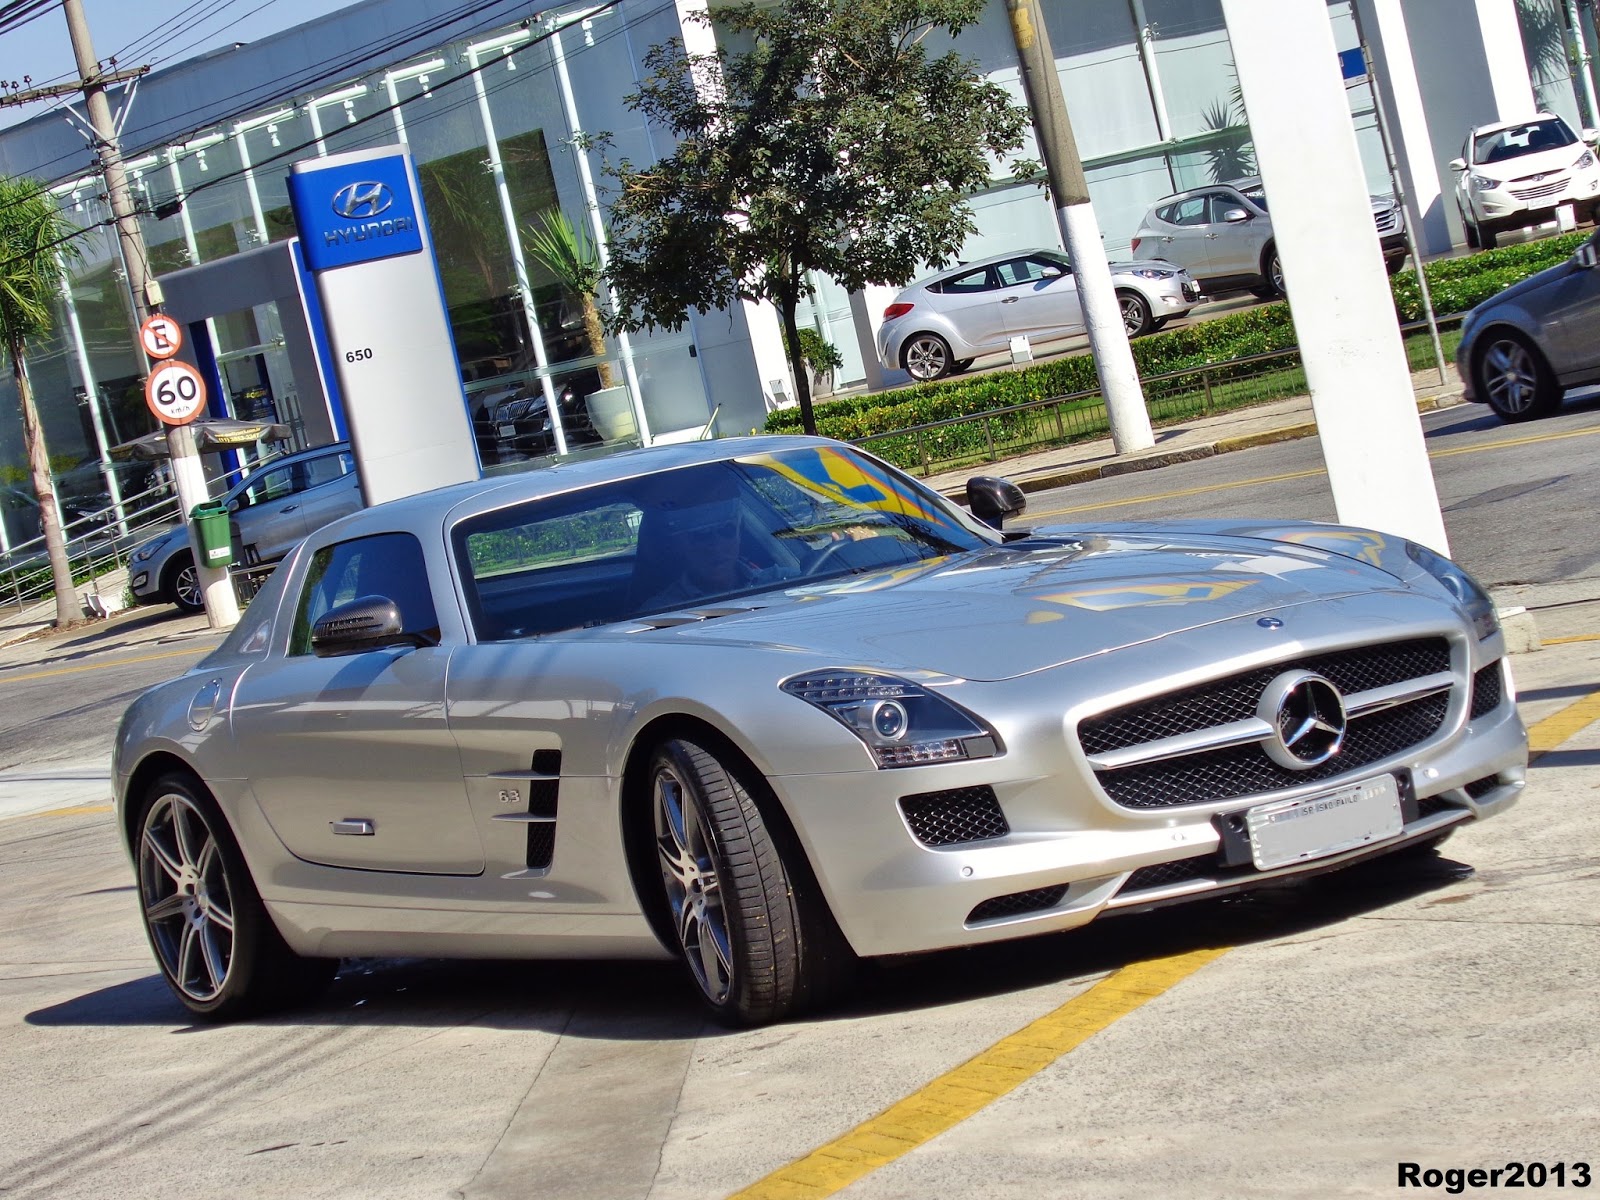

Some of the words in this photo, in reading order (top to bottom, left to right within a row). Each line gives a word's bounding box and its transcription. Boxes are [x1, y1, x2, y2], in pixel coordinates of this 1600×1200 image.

[323, 217, 413, 247] HYUNDAI
[346, 348, 373, 363] 650
[157, 376, 196, 405] 60
[171, 405, 190, 414] km/h
